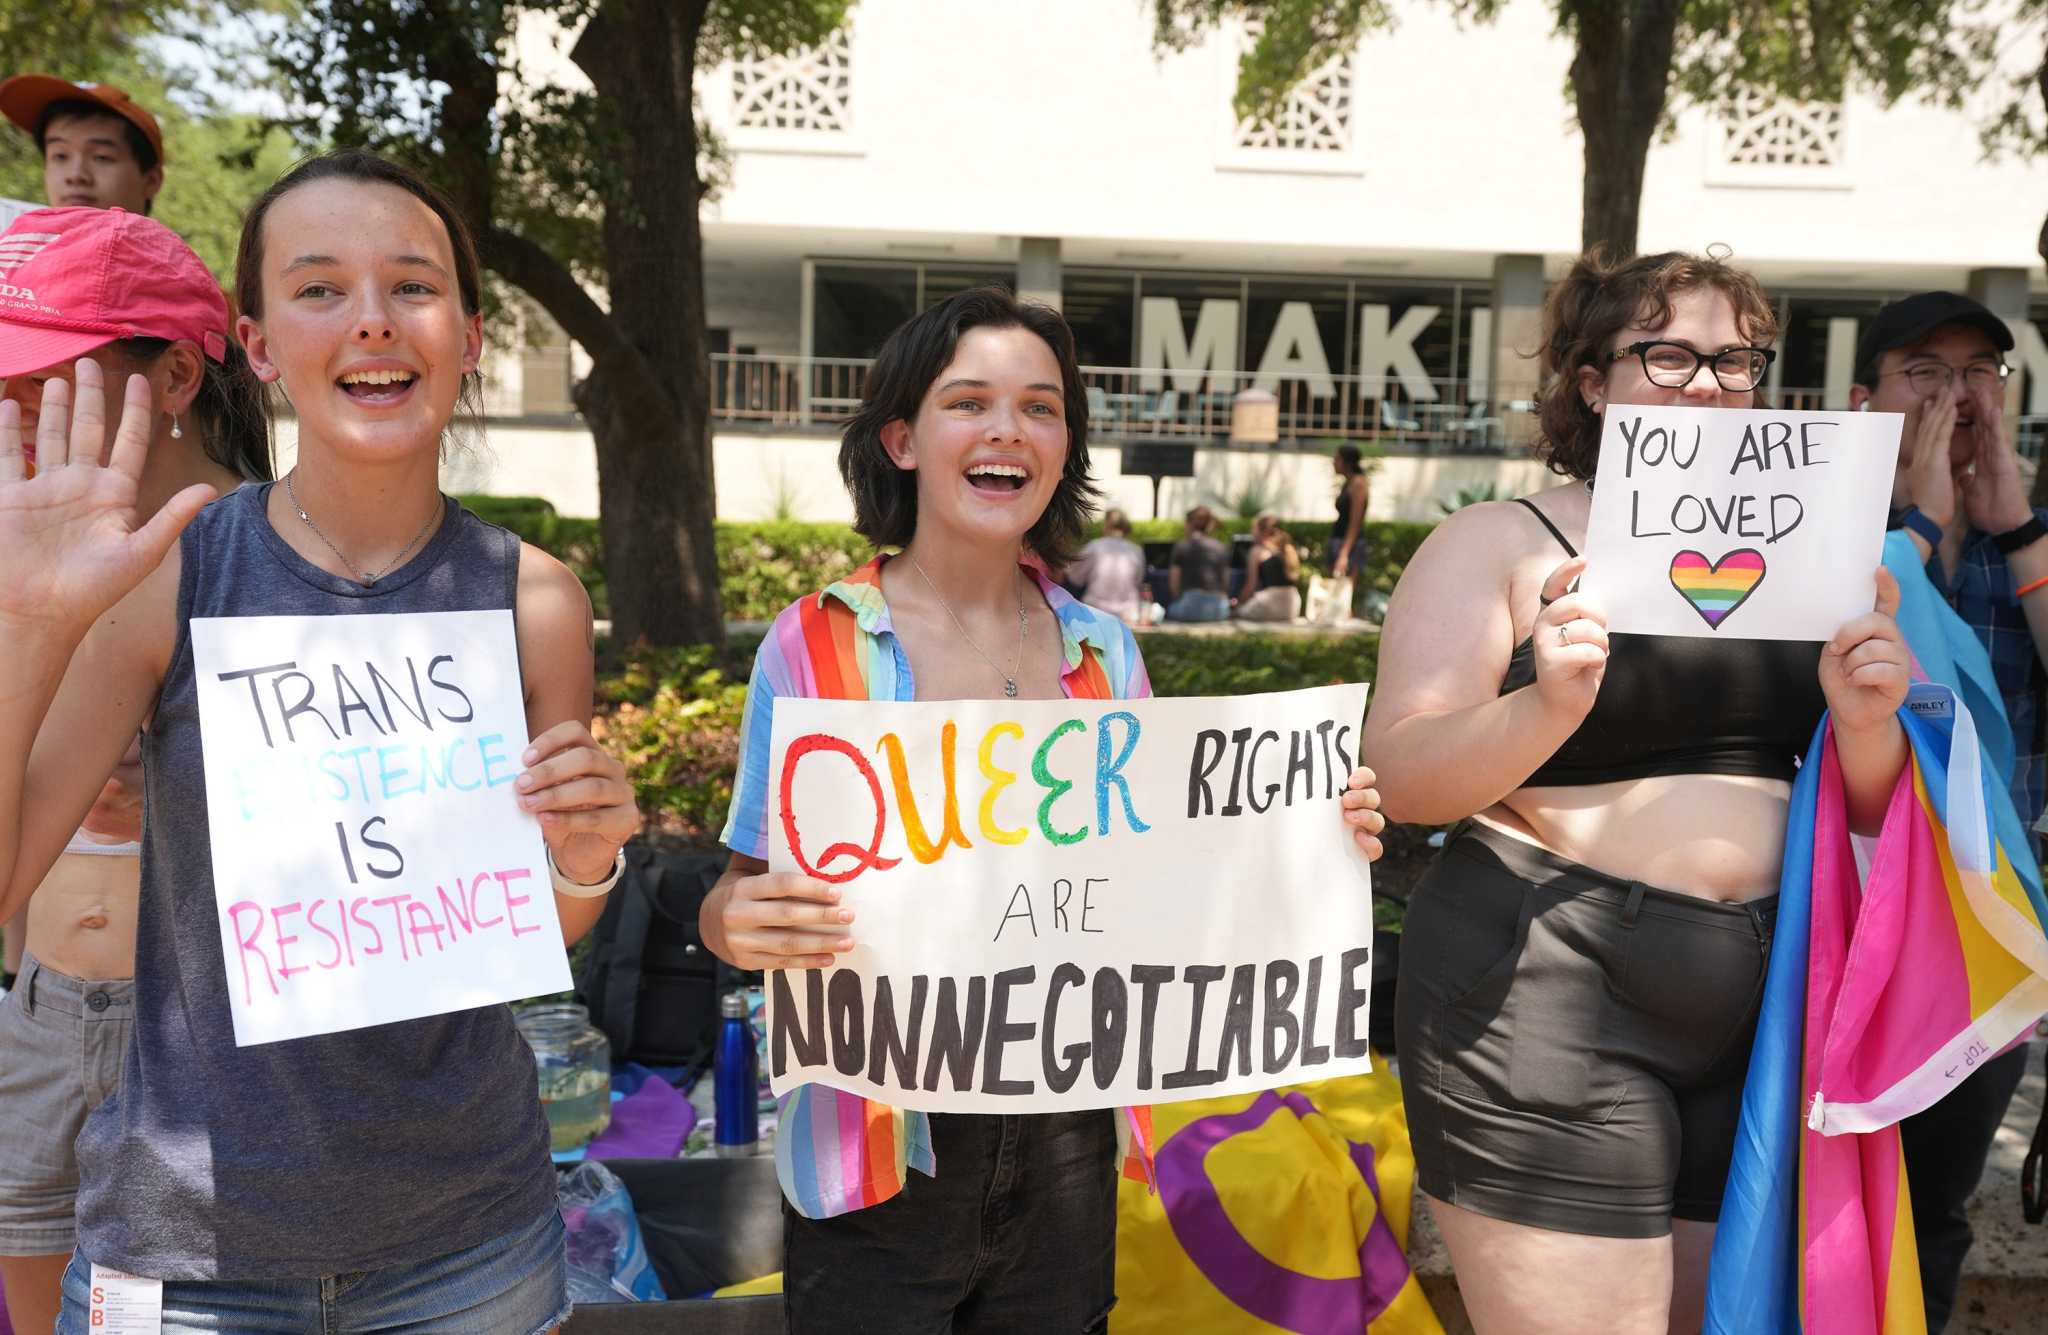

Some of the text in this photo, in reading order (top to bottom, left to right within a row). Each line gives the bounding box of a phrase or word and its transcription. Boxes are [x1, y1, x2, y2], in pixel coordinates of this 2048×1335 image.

[1619, 417, 1840, 478] YOU ARE
[1631, 490, 1804, 544] LOVED
[217, 654, 474, 749] TRANS
[779, 710, 1352, 884] QUEER RIGHTS
[335, 815, 404, 884] IS
[228, 868, 541, 1006] RESISTANCE
[993, 877, 1110, 942] ARE
[770, 947, 1370, 1095] NONNEGOTIABLE
[1964, 1041, 1990, 1066] TOP
[91, 1309, 104, 1326] B
[92, 1287, 104, 1304] S
